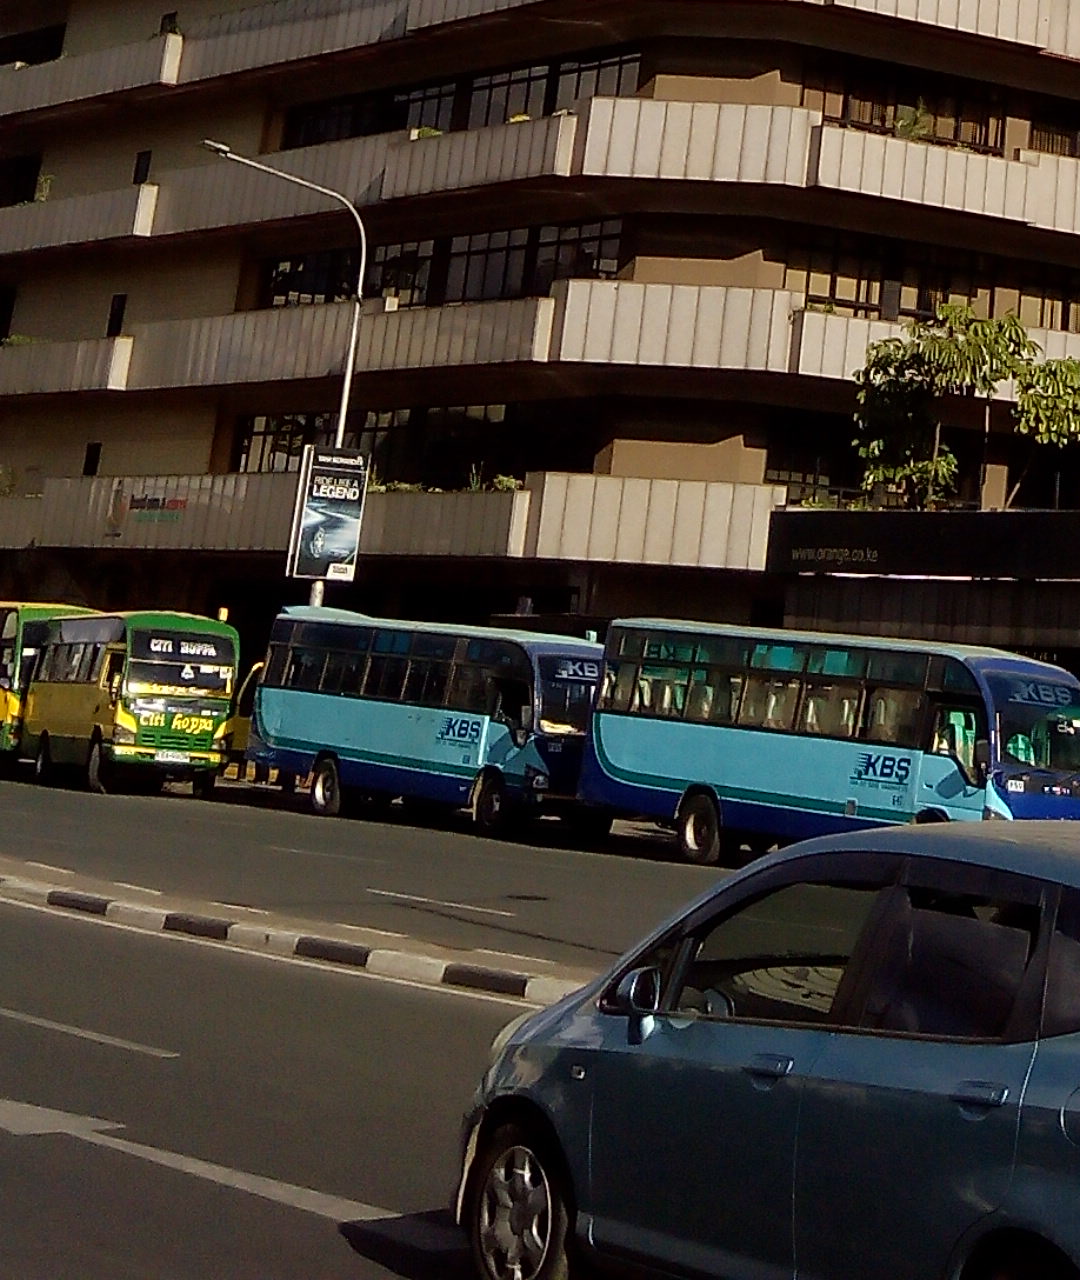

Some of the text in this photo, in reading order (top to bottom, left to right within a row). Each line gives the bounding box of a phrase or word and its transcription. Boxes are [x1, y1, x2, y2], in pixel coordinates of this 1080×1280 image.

[312, 484, 359, 500] LEGEND
[567, 660, 599, 677] KB
[1025, 682, 1073, 705] KBS
[446, 717, 481, 740] KBS
[862, 752, 912, 781] KBS
